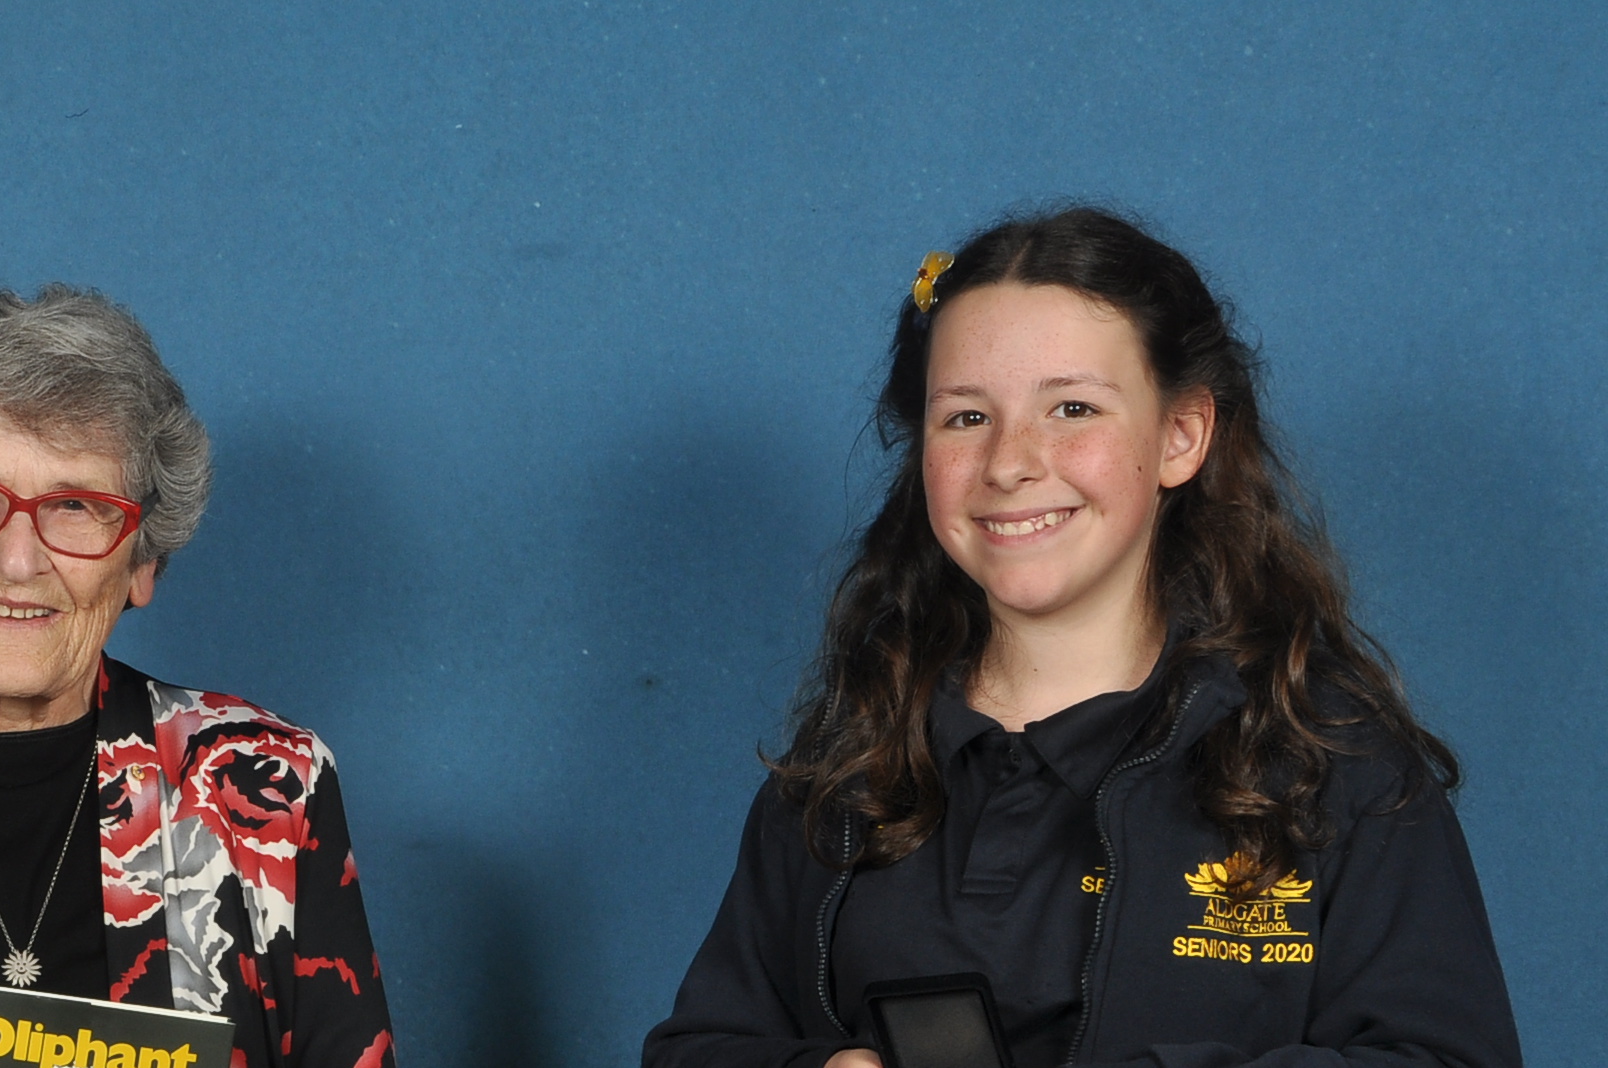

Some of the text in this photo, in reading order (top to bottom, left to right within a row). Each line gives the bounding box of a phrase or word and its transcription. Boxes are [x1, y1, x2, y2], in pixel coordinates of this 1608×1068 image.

[1205, 898, 1287, 922] ALDGATE
[1203, 915, 1292, 934] PRIMARY SCHOOL
[1172, 936, 1314, 964] SENIORS 2020
